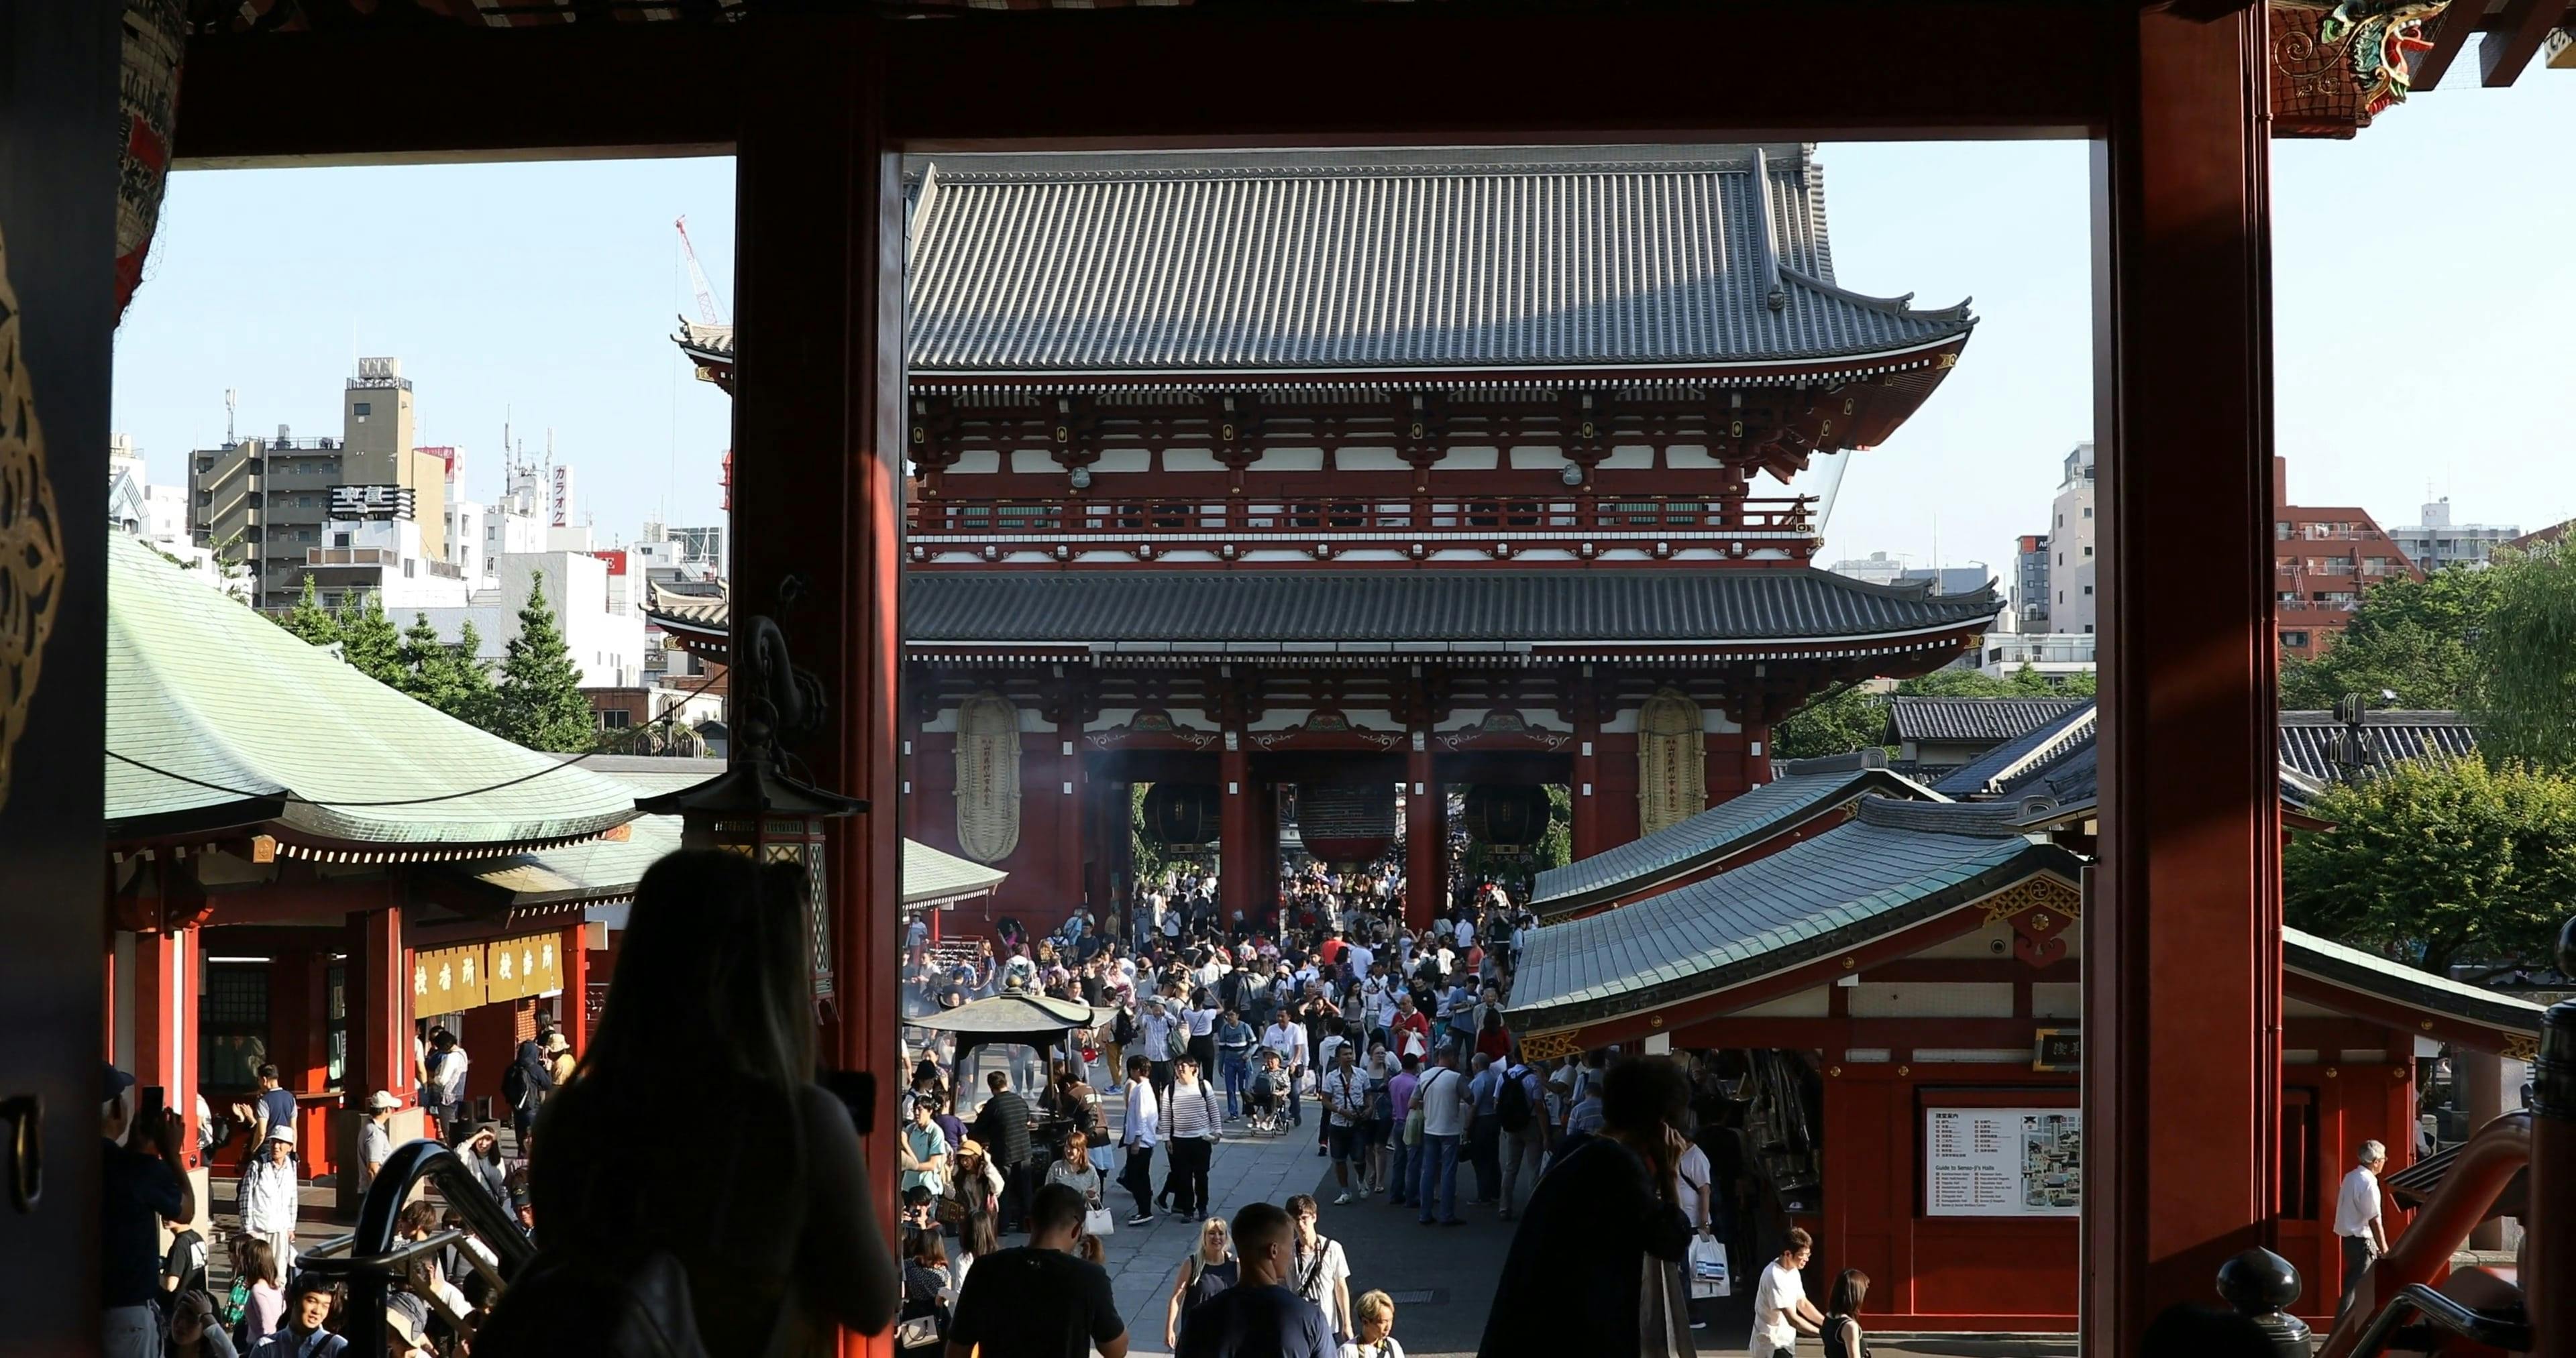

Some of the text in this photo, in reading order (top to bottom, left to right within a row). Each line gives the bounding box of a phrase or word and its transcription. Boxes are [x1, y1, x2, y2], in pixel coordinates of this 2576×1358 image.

[341, 486, 382, 504] 中屋
[554, 467, 565, 522] カラオケ
